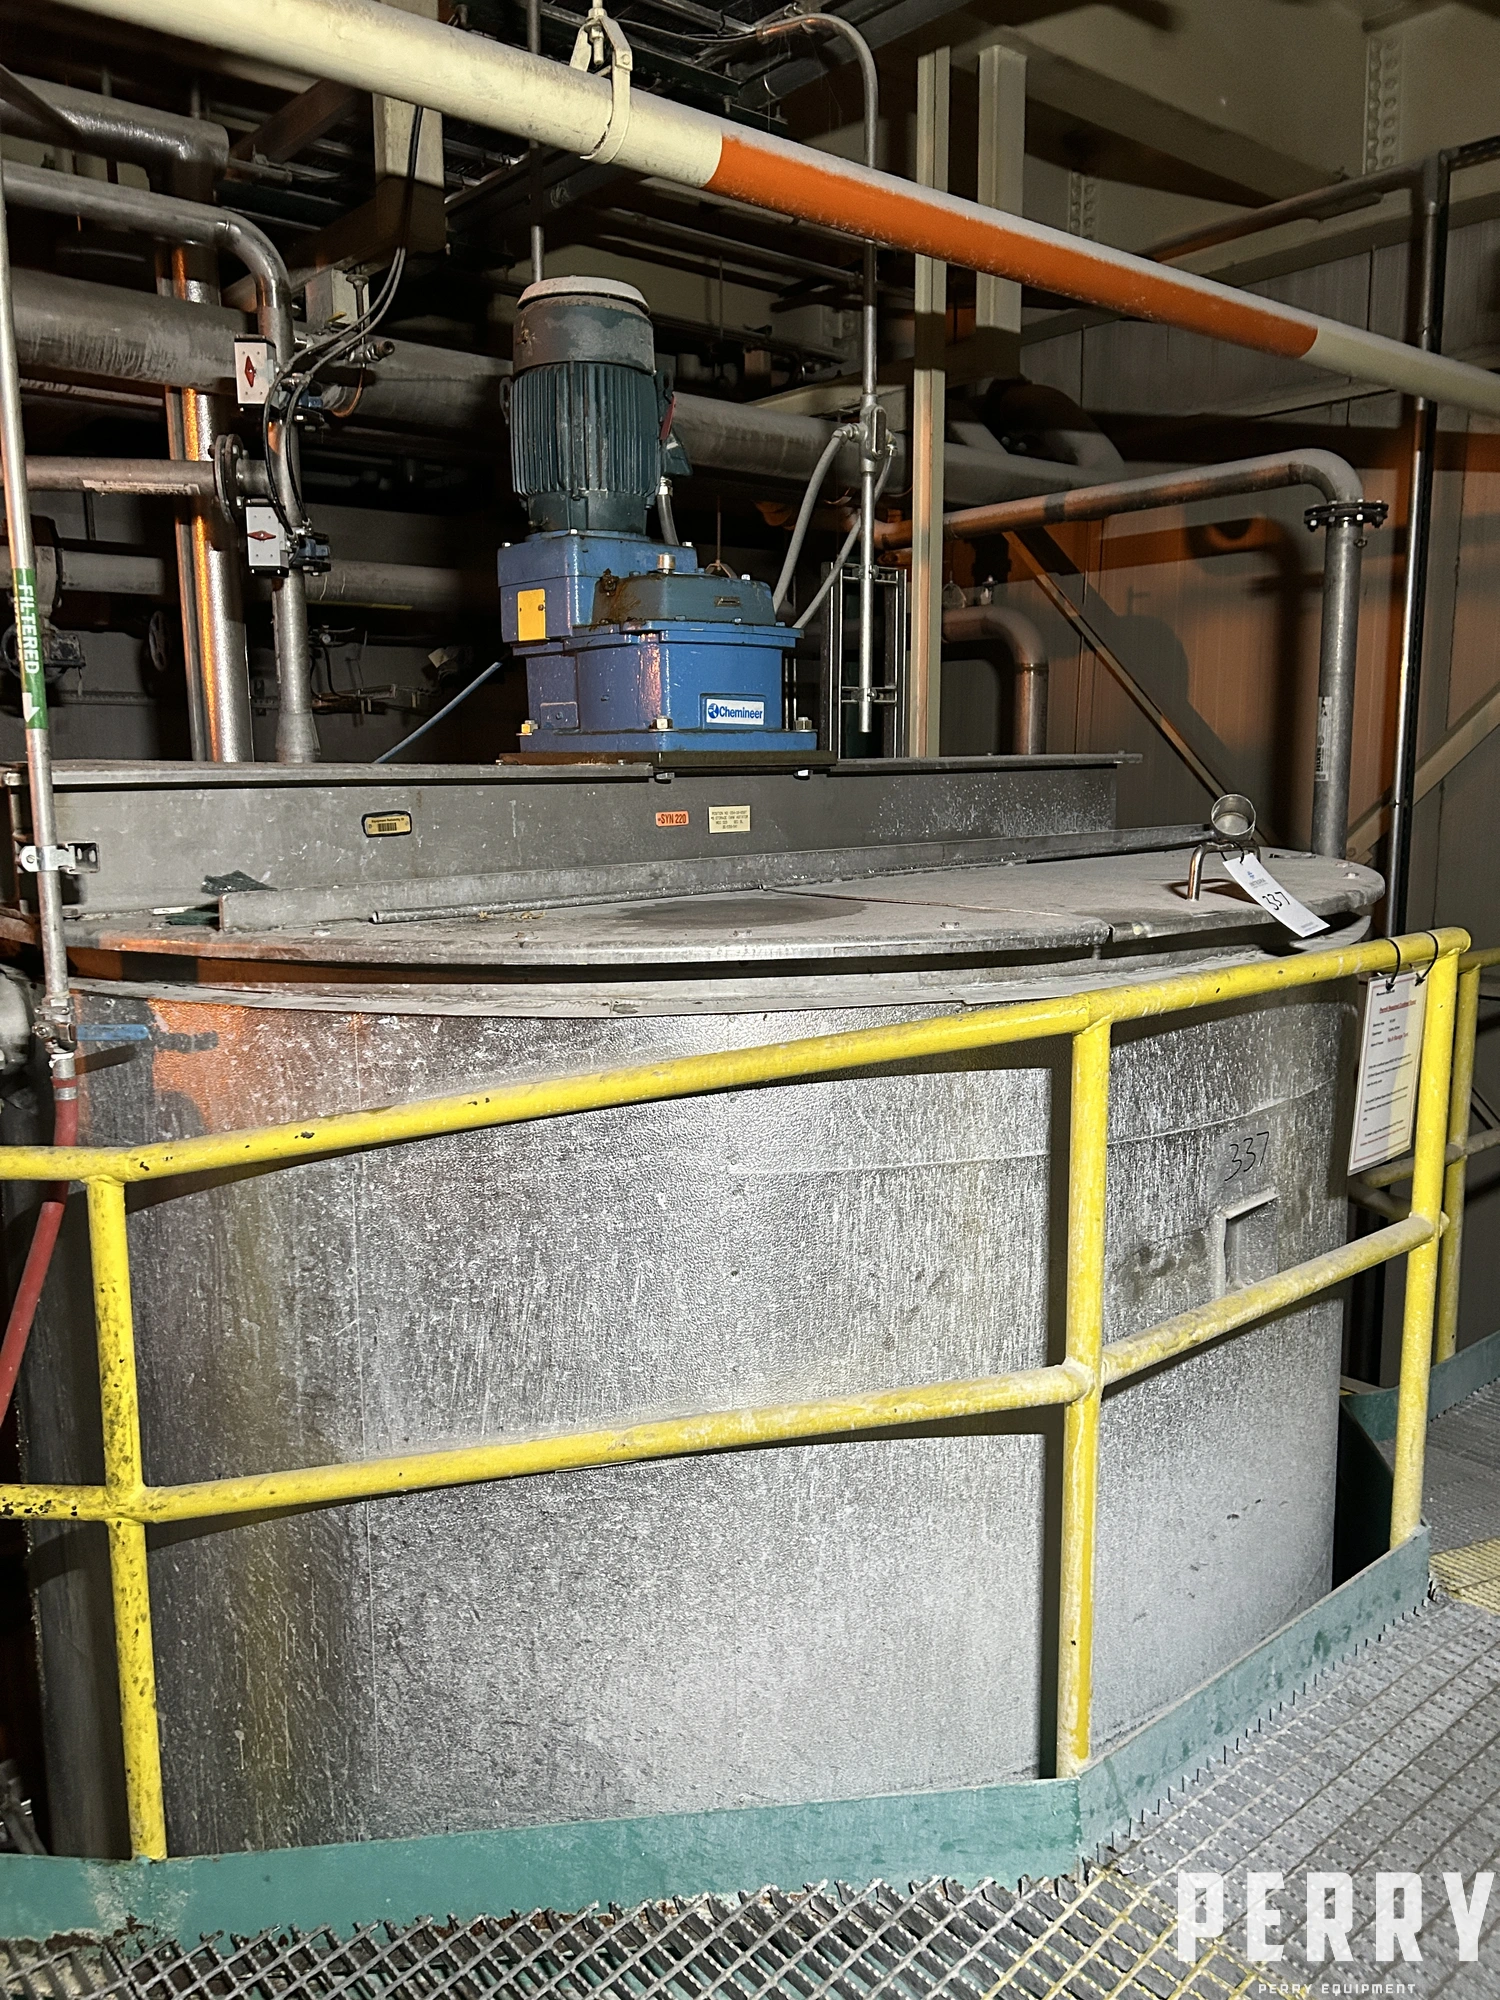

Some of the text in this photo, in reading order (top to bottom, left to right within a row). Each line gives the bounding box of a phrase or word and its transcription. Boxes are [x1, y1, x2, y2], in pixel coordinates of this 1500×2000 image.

[18, 584, 40, 675] FILTERED
[720, 706, 763, 719] Chemineer
[661, 813, 687, 824] SYN 220
[1262, 891, 1290, 911] 337
[1224, 1130, 1270, 1182] 337
